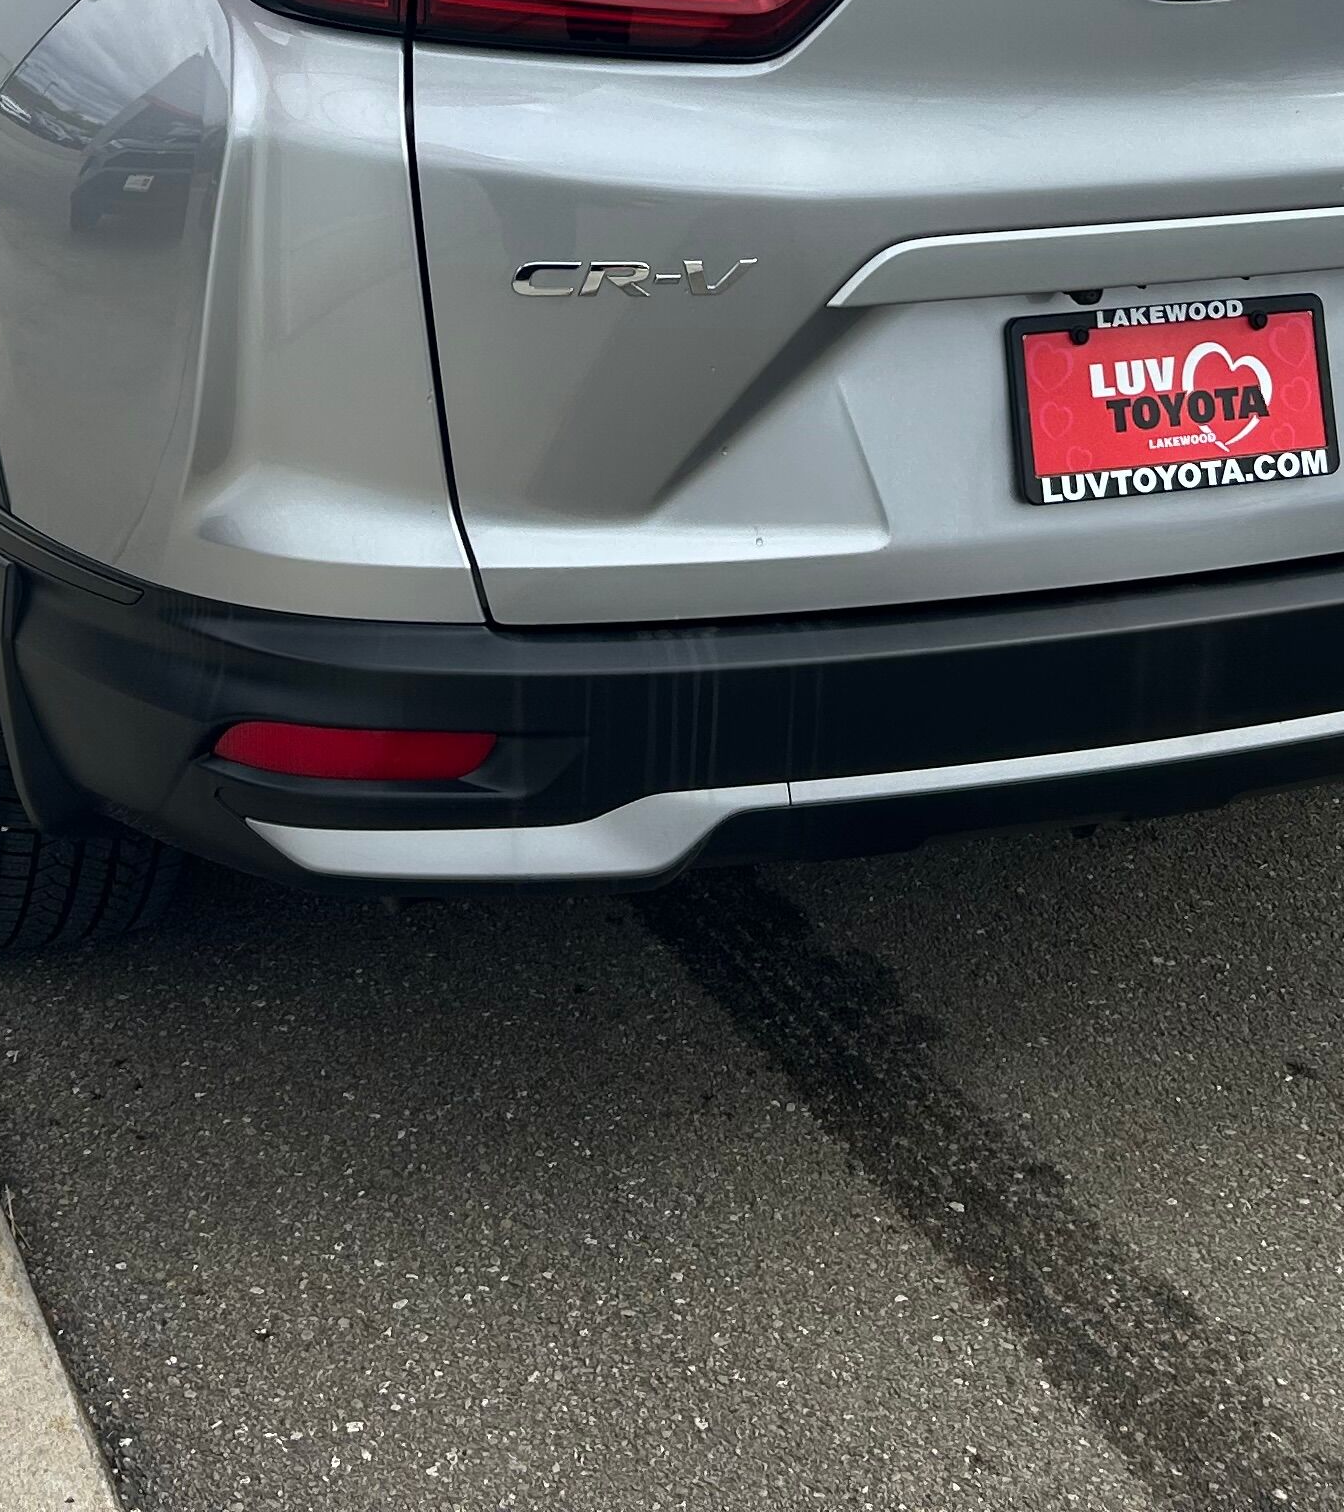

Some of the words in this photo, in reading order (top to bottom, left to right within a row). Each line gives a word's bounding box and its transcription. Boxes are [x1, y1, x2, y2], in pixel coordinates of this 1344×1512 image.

[511, 257, 758, 297] CR-V
[1096, 299, 1244, 329] LAKEWOOD
[1088, 356, 1175, 399] LUV
[1105, 385, 1269, 433] TOYOTA
[1148, 431, 1217, 450] LAKEWOOD
[1040, 449, 1329, 504] LUVTOYOTA.COM
